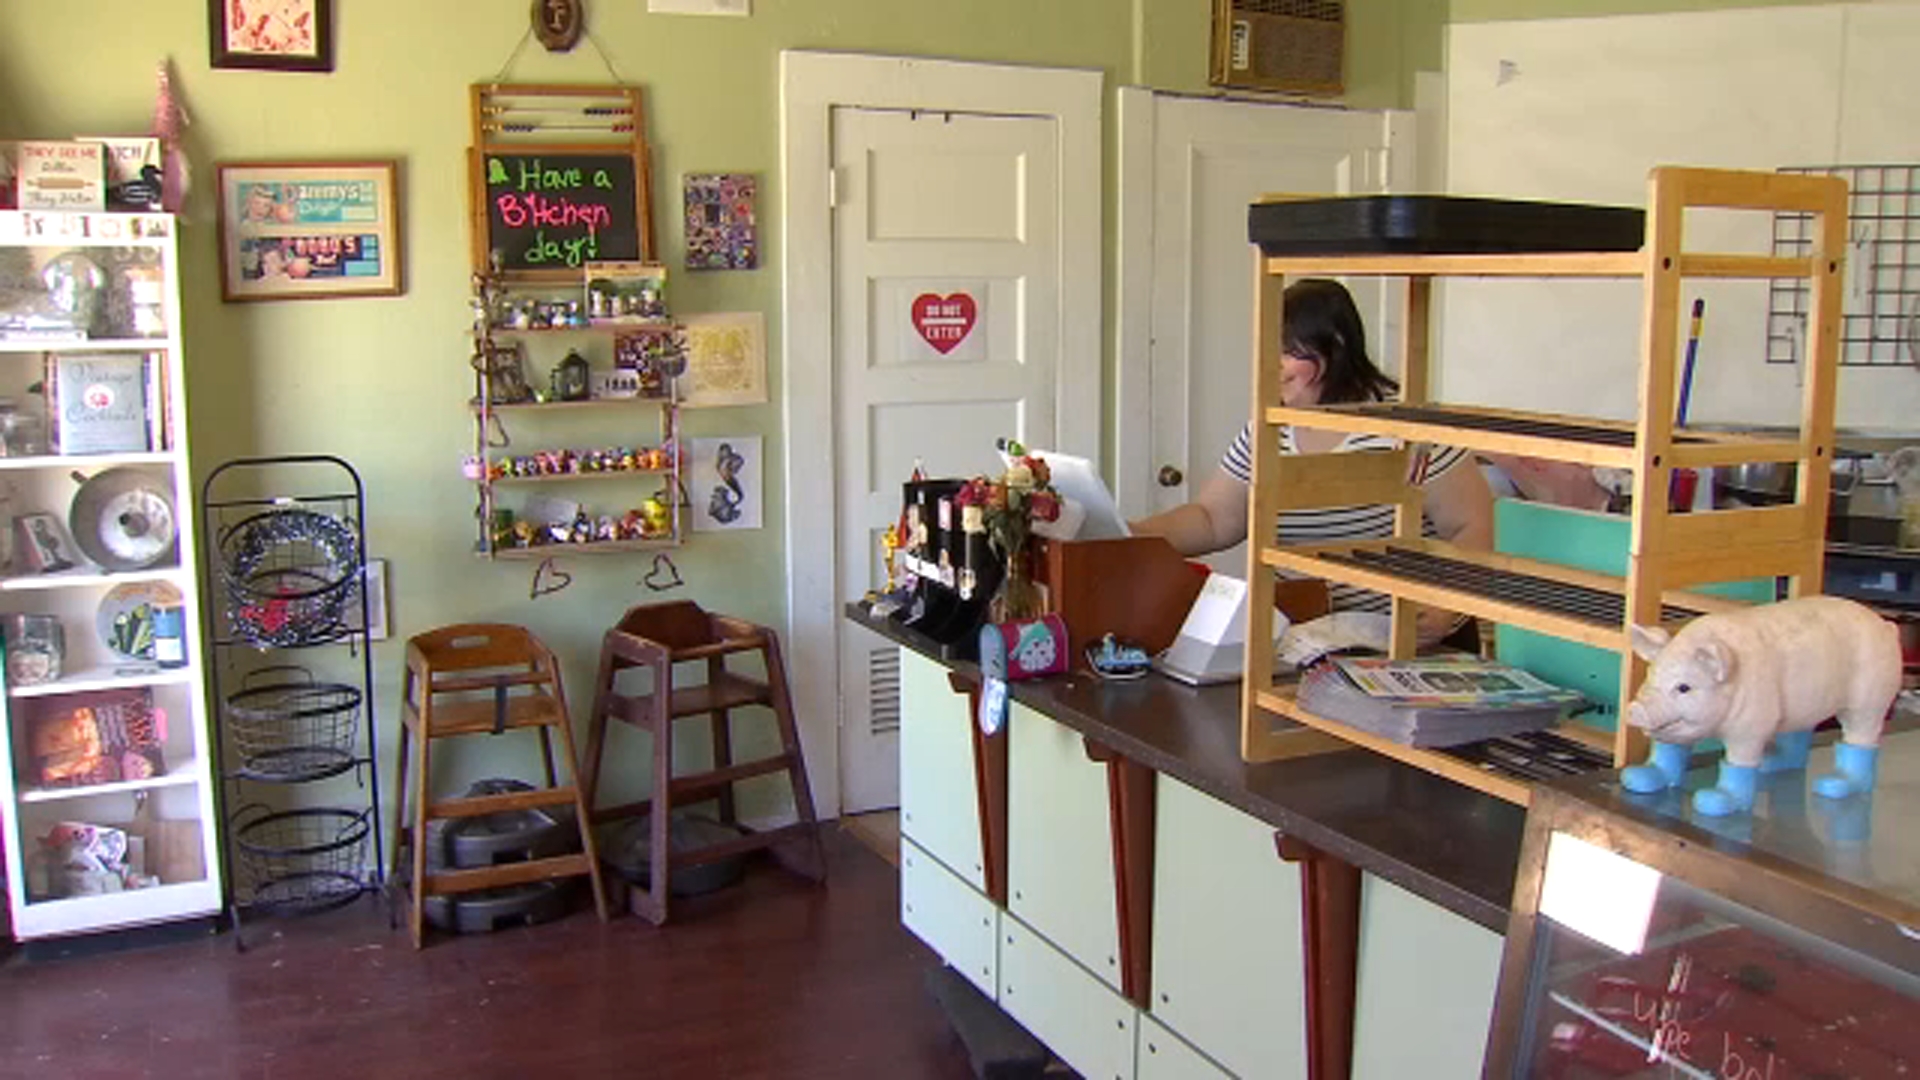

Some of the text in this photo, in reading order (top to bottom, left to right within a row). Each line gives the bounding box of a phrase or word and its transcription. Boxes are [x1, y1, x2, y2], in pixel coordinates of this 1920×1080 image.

[24, 146, 54, 158] THEY
[81, 147, 97, 158] ME
[517, 158, 613, 191] Have a
[525, 224, 598, 268] day!
[925, 305, 961, 316] DO NOT
[926, 326, 961, 339] ENTER
